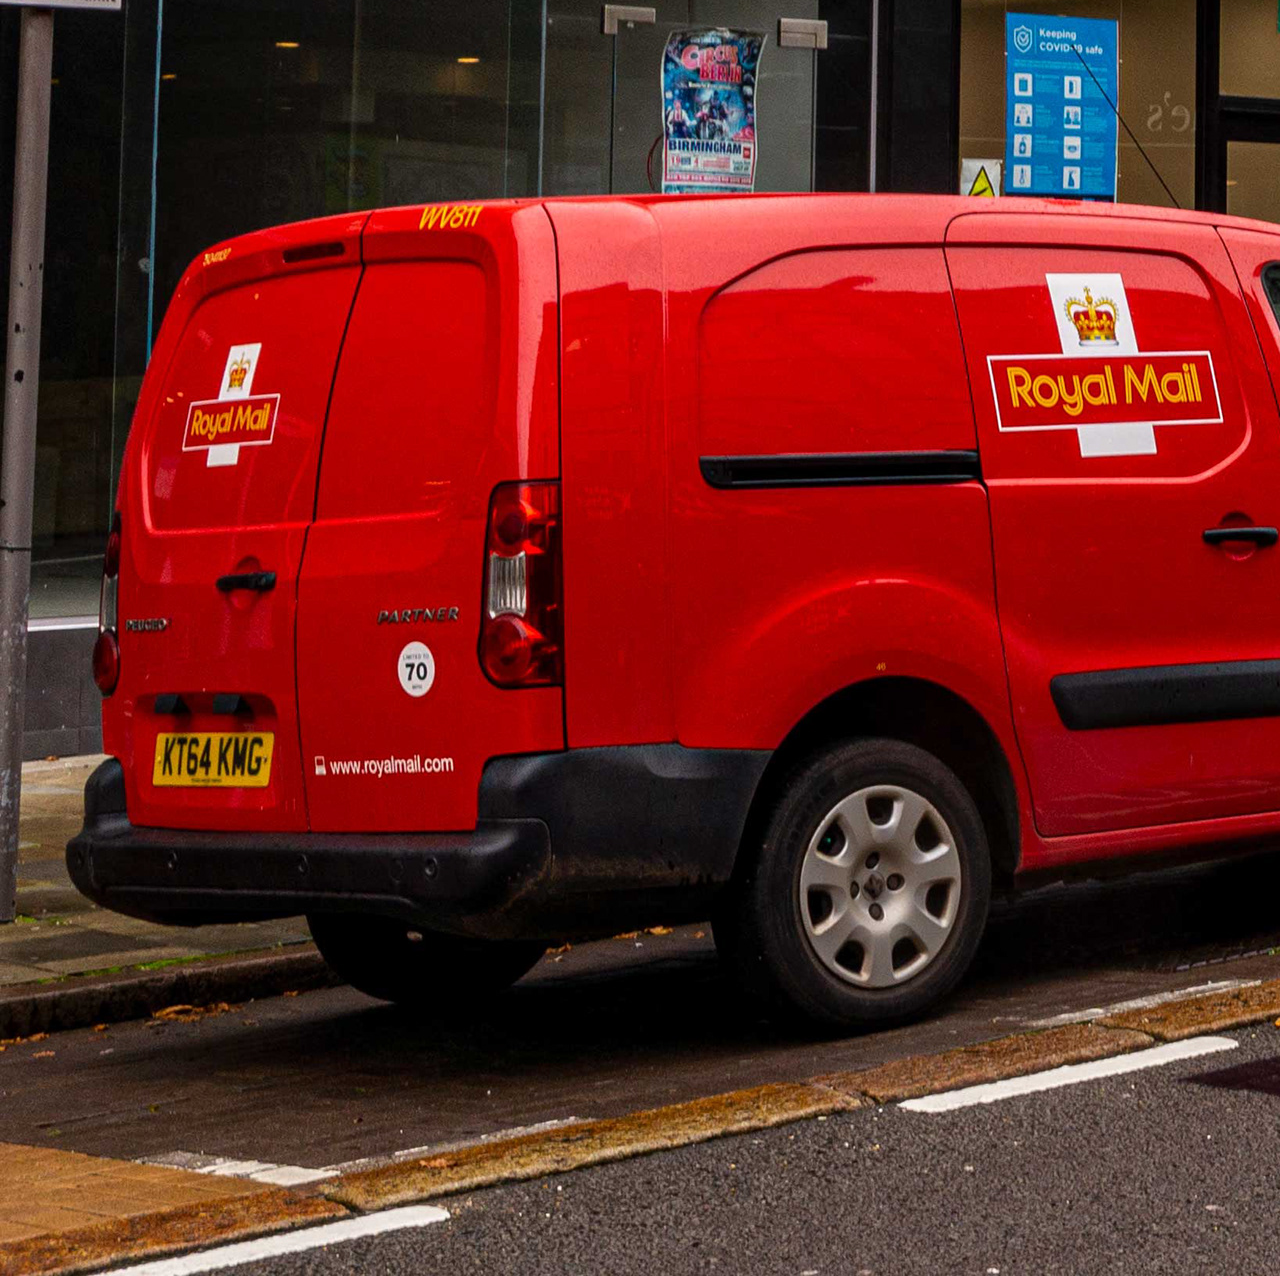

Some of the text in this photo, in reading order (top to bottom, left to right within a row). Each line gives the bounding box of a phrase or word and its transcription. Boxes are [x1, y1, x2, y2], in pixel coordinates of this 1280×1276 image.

[1039, 27, 1077, 41] Keeping
[1085, 45, 1103, 56] safe
[668, 139, 742, 156] BIRMINGHAM
[1006, 363, 1202, 416] Royal Mail
[190, 403, 271, 441] Royal Mail
[378, 606, 460, 624] PARTNER
[405, 662, 428, 682] 70
[162, 736, 264, 776] KT64 KMG
[330, 754, 455, 778] www.royalmail.com
